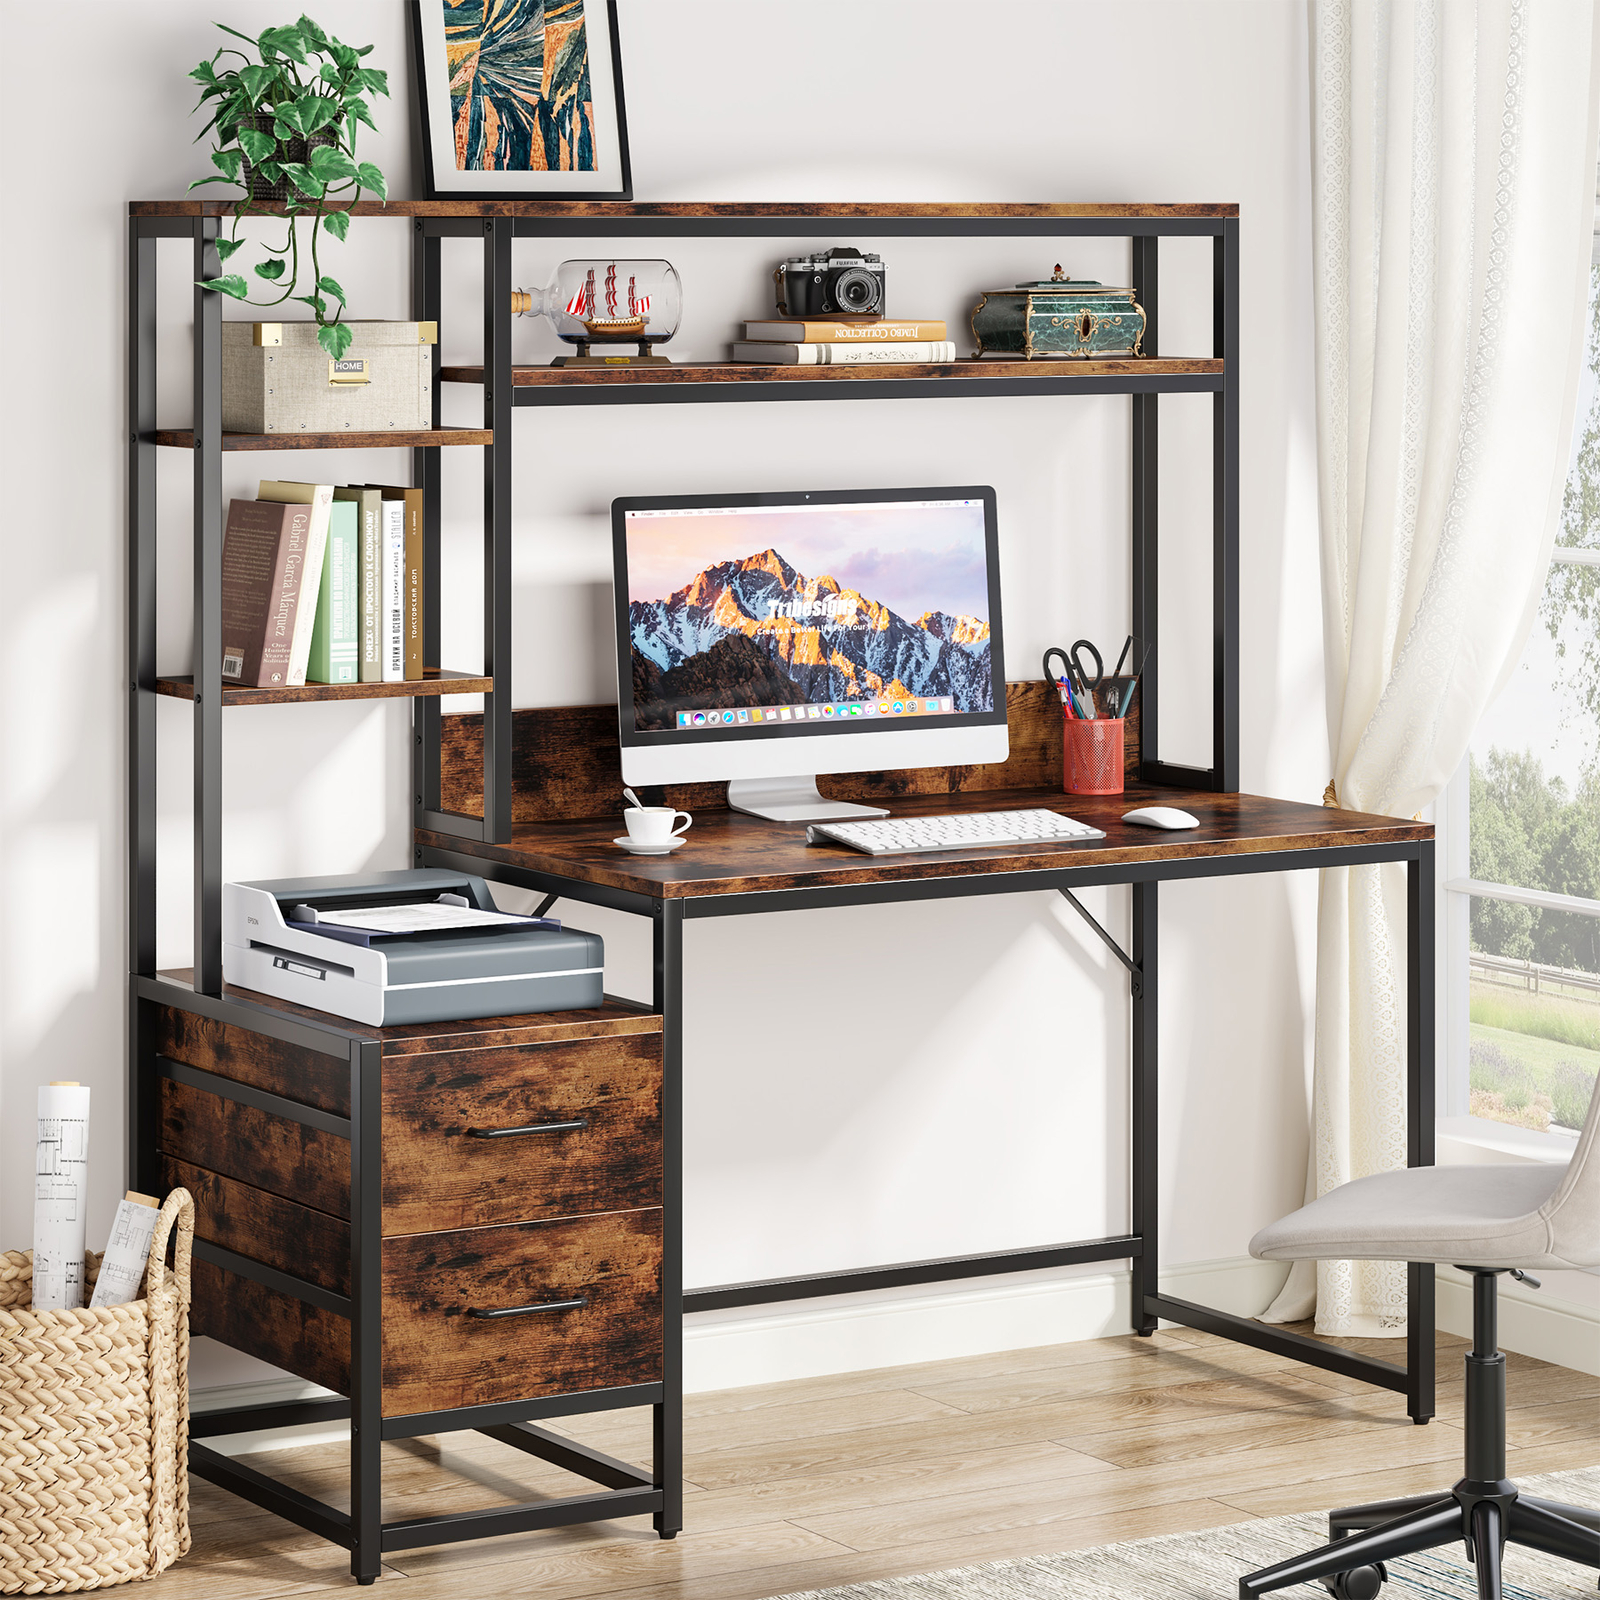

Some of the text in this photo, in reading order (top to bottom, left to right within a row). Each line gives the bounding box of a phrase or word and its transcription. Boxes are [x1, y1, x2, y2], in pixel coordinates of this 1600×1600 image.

[835, 325, 919, 339] JUMBO COLLECTION
[335, 362, 363, 370] HOME
[366, 510, 374, 562] СЛОЖНОМУ
[273, 513, 308, 637] Gabriel García Márquez
[366, 571, 374, 614] ПРОСТОГО
[767, 596, 858, 619] Tribesigns
[366, 614, 374, 627] ОТ
[757, 627, 784, 636] Create
[791, 626, 815, 634] Better
[817, 625, 832, 633] Life
[366, 629, 374, 662] FOREX:
[247, 916, 259, 926] EPSON
